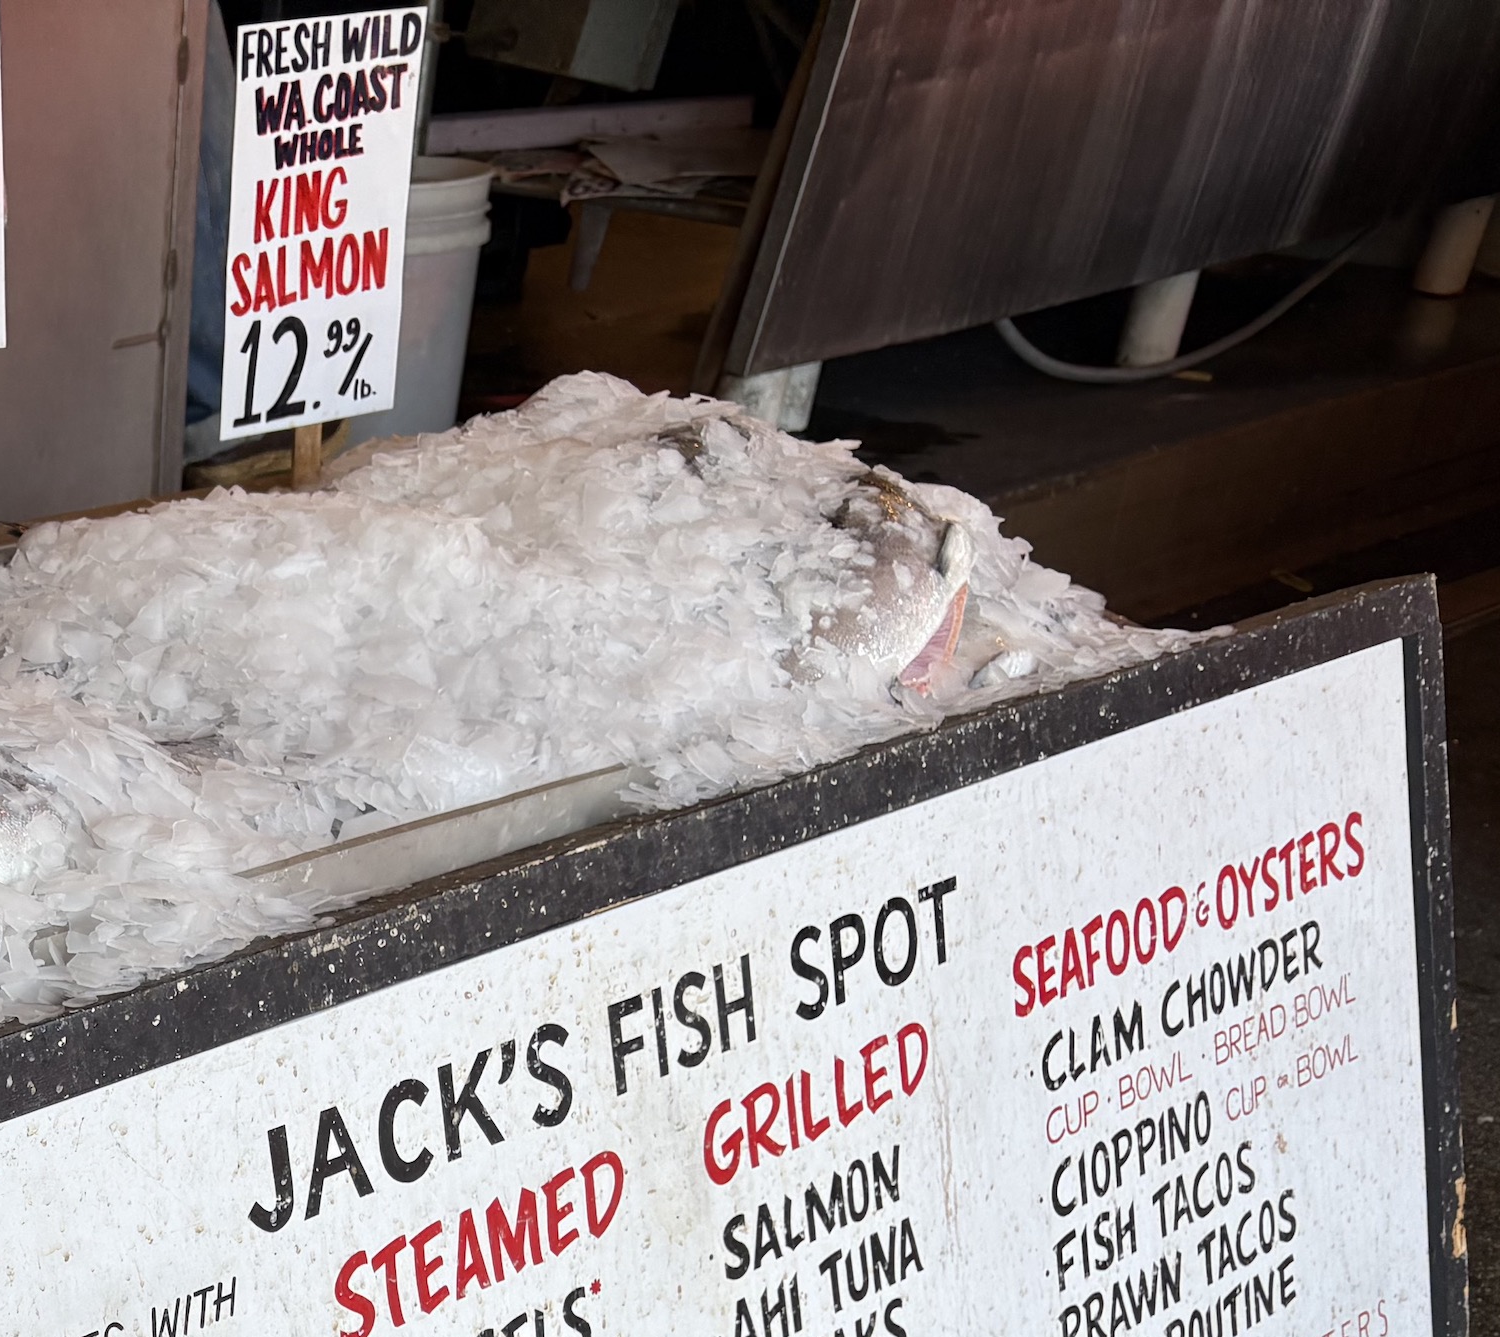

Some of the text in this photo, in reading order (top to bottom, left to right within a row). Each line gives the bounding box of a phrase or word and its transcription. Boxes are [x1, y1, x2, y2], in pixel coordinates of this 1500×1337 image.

[241, 11, 423, 81] FRESH WILD
[254, 166, 349, 244] KING
[273, 122, 364, 170] WHOLE
[230, 227, 389, 318] SALMON
[1012, 811, 1365, 1018] SEAFOOD & OYSTERS
[247, 875, 957, 1233] JACK'S FISH SPOT
[1040, 919, 1323, 1092] CLAM CHOWDER
[1046, 972, 1356, 1144] CUP BOWL BREAD BOWL
[703, 1022, 929, 1186] GRILLED
[1050, 1090, 1213, 1218] CIOPPINO
[1226, 1075, 1266, 1121] CUP
[1297, 1034, 1359, 1088] BOWL
[722, 1144, 900, 1281] SALMON
[819, 1217, 925, 1304] TUNA
[1052, 1140, 1256, 1293] FISH TACOS
[1196, 1188, 1297, 1286] TACOS
